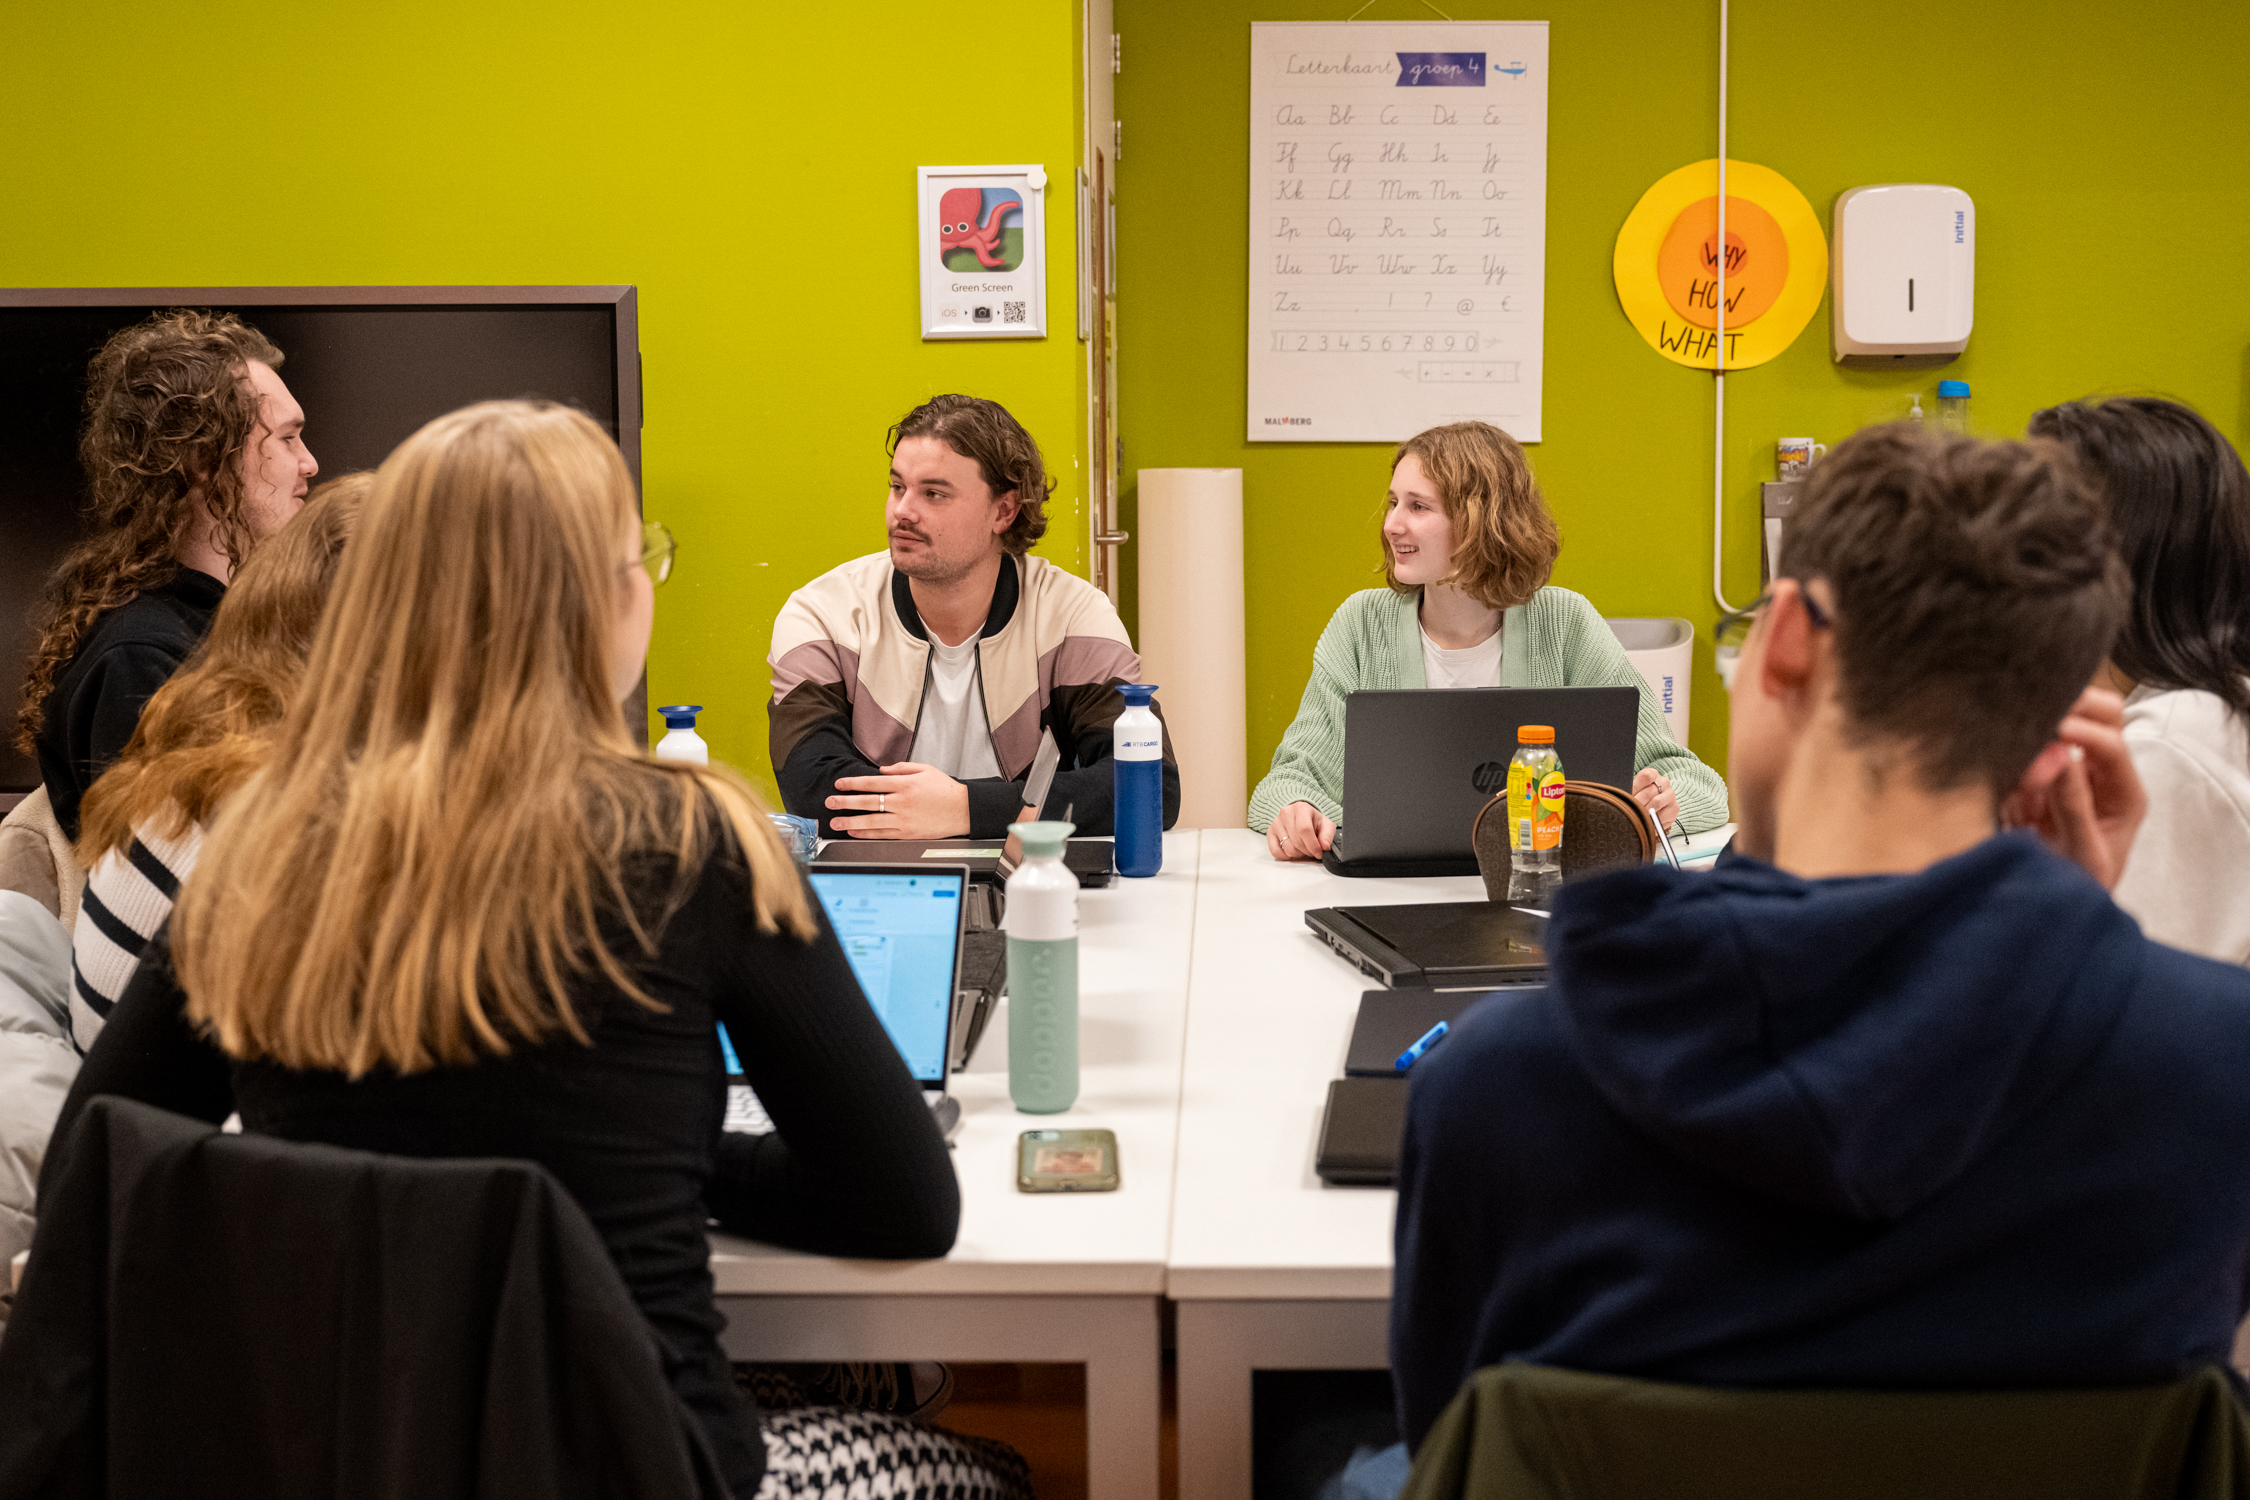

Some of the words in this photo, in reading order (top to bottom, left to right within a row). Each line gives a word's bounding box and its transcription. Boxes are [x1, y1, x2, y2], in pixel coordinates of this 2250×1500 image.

[1286, 54, 1394, 75] Letterkaart
[1409, 63, 1464, 85] groep
[1468, 58, 1480, 74] 4
[1276, 105, 1307, 125] Aa
[1329, 105, 1355, 125] Bb
[1379, 105, 1399, 125] Cc
[1432, 105, 1458, 125] Dd
[1483, 105, 1502, 125] Ee
[1276, 143, 1299, 173] Ff
[1327, 143, 1354, 173] Gg
[1379, 143, 1408, 163] Hh
[1482, 143, 1501, 173] Jj
[1275, 180, 1304, 201] Kk
[1327, 180, 1352, 201] Ll
[1378, 180, 1422, 201] Mm
[1430, 180, 1462, 201] Nn
[1482, 180, 1509, 201] Oo
[1275, 217, 1301, 242] Pp
[1327, 217, 1356, 242] Qq
[1378, 217, 1407, 237] Rr
[1430, 217, 1448, 237] Ss
[1481, 217, 1503, 237] Tt
[1955, 210, 1965, 244] Initial
[1275, 254, 1302, 275] Uu
[1329, 254, 1359, 275] Vv
[1377, 254, 1416, 275] Ww
[1430, 254, 1458, 275] Xx
[1481, 254, 1508, 285] Yy
[951, 283, 979, 293] Green
[982, 283, 1013, 293] Screen
[1688, 278, 1745, 313] HOW
[941, 308, 957, 318] iOS
[1275, 291, 1302, 312] Zz
[1457, 298, 1475, 315] @
[1659, 320, 1744, 361] WHAT
[1264, 417, 1312, 426] MALMBERG
[1662, 676, 1673, 714] Initial
[1475, 761, 1505, 794] hp
[1537, 826, 1560, 834] PEACH
